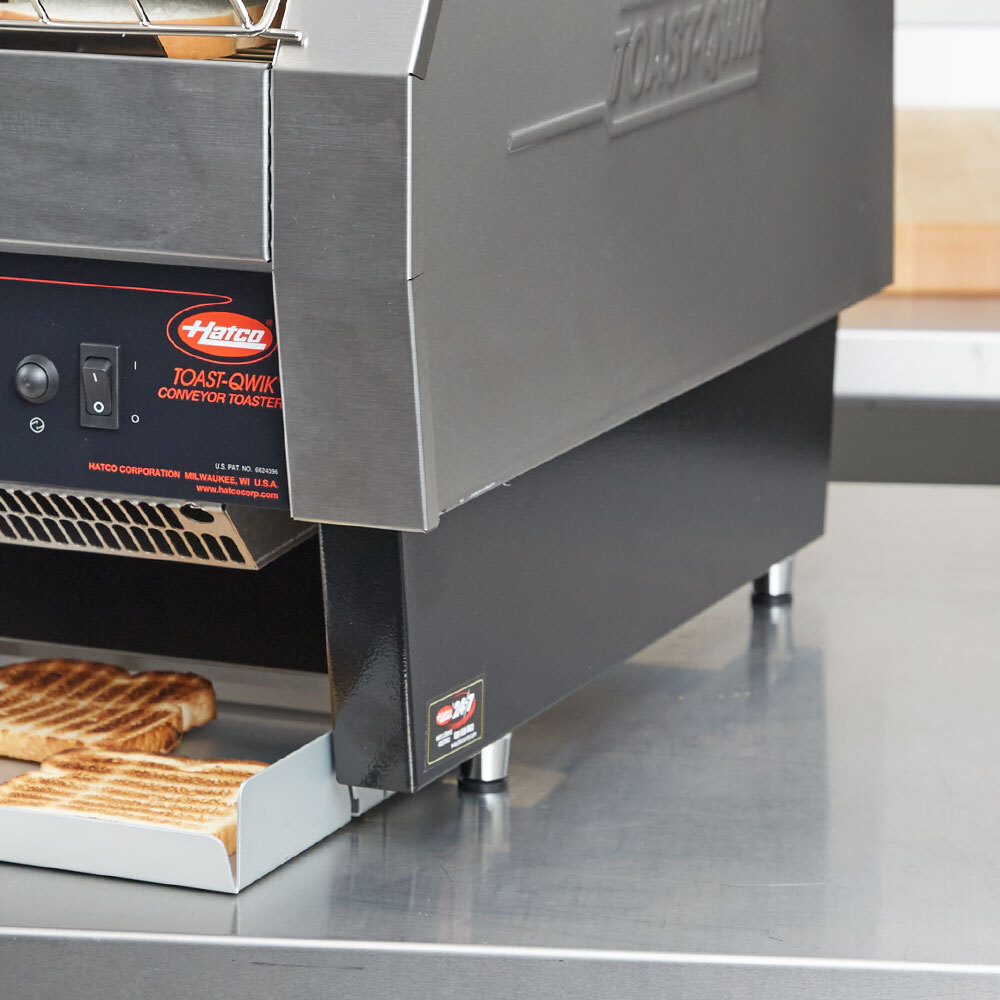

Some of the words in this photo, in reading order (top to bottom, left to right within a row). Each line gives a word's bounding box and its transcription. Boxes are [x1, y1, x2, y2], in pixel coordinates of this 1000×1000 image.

[182, 320, 266, 350] Hatco
[174, 367, 278, 393] TOAST-QWIK
[158, 387, 225, 403] CONVEYOR
[228, 393, 282, 408] TOASTER
[88, 462, 118, 472] HATCO
[119, 465, 180, 478] CORPORATION
[184, 472, 238, 485] MILWAUKEE,
[239, 477, 250, 486] WI
[254, 479, 279, 488] U.S.A.
[196, 485, 279, 499] www.hatcocorp.com
